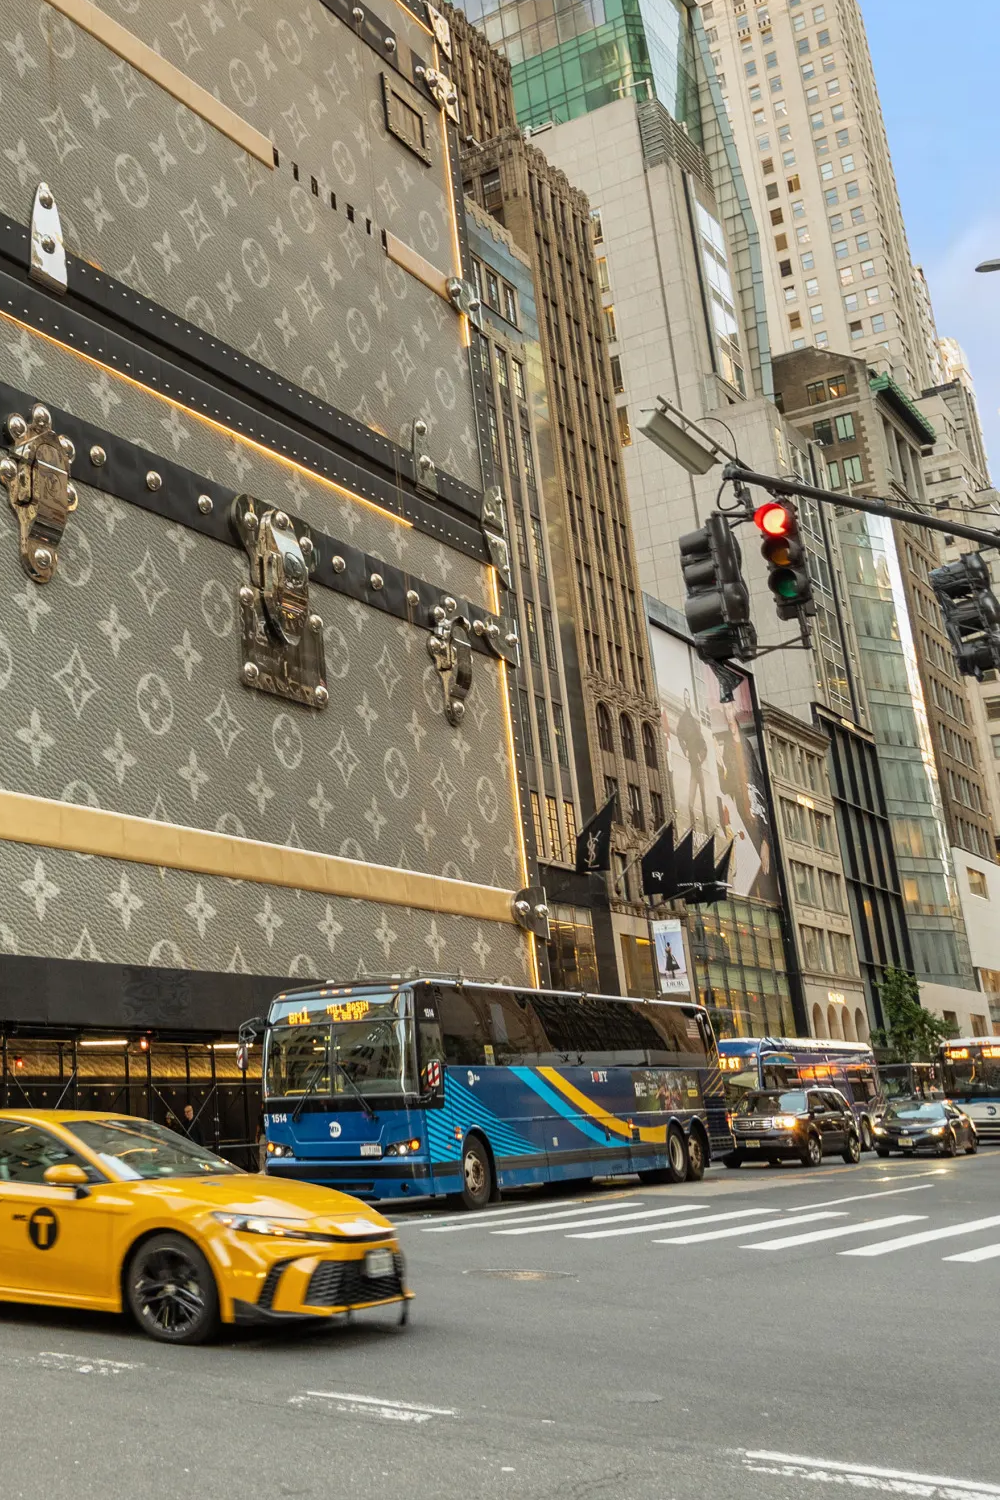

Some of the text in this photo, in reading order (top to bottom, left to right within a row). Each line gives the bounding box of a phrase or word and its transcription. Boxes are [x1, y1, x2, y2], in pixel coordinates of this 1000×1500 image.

[326, 1001, 369, 1014] MILL BASIN
[288, 1011, 311, 1025] BM1
[728, 1057, 740, 1069] ST
[271, 1114, 287, 1123] 1514
